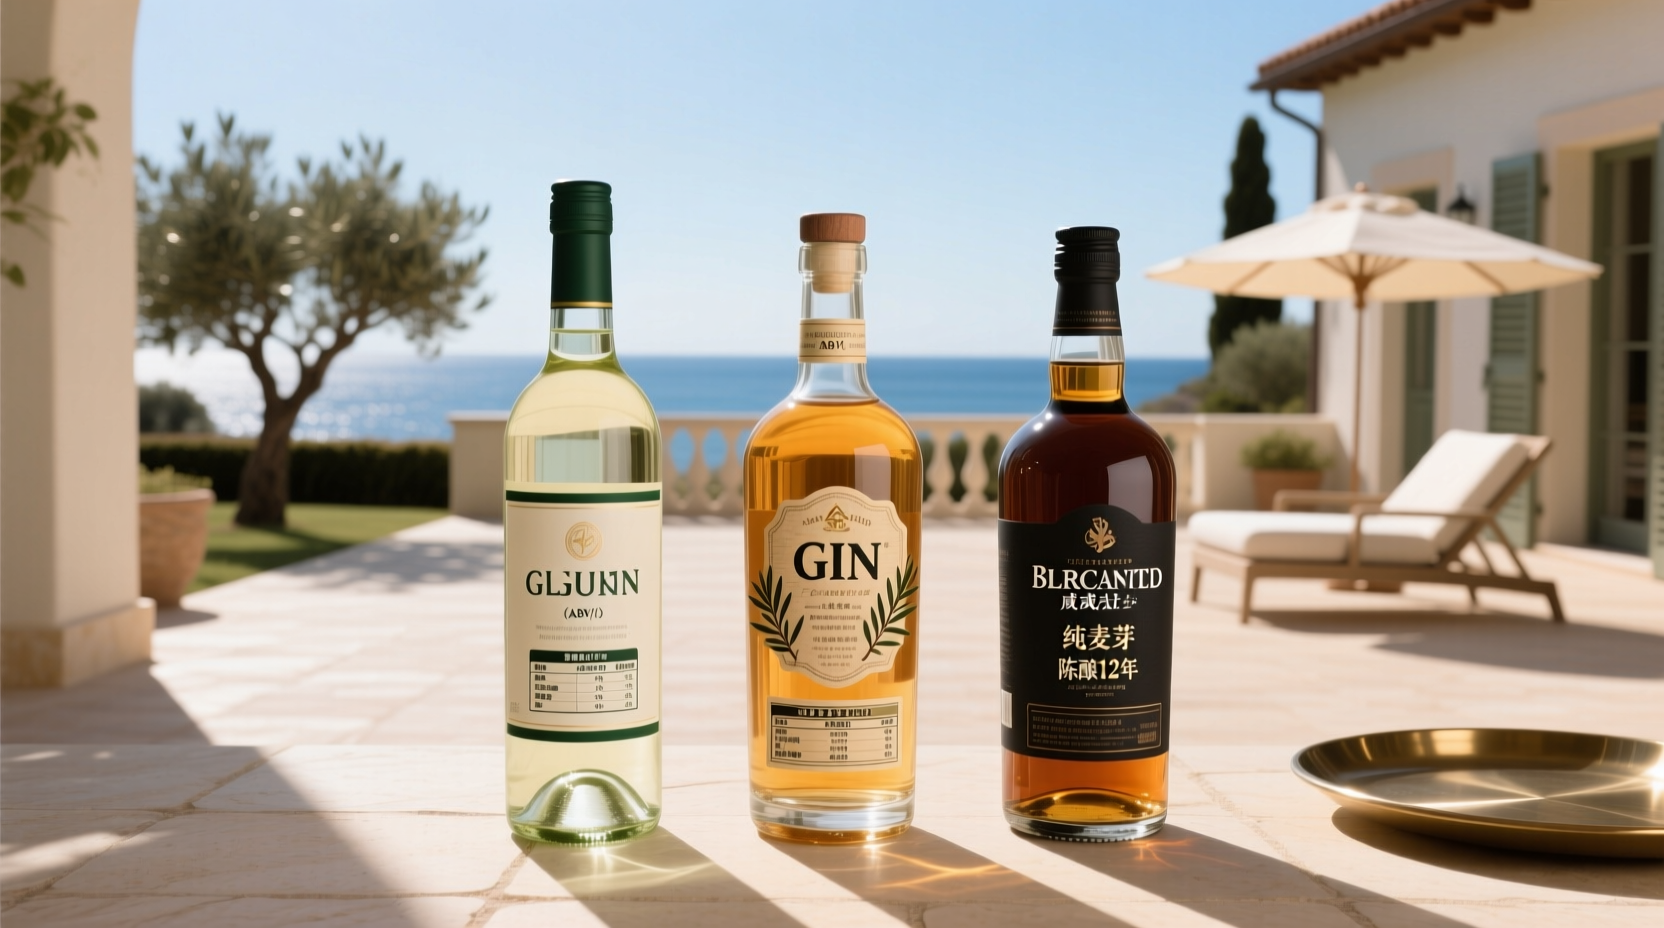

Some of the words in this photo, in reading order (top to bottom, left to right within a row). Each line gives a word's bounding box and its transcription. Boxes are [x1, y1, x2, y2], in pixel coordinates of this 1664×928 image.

[794, 541, 881, 580] GIN
[1062, 624, 1135, 650] 纯麦芽
[1058, 656, 1138, 680] 陈酿12年
